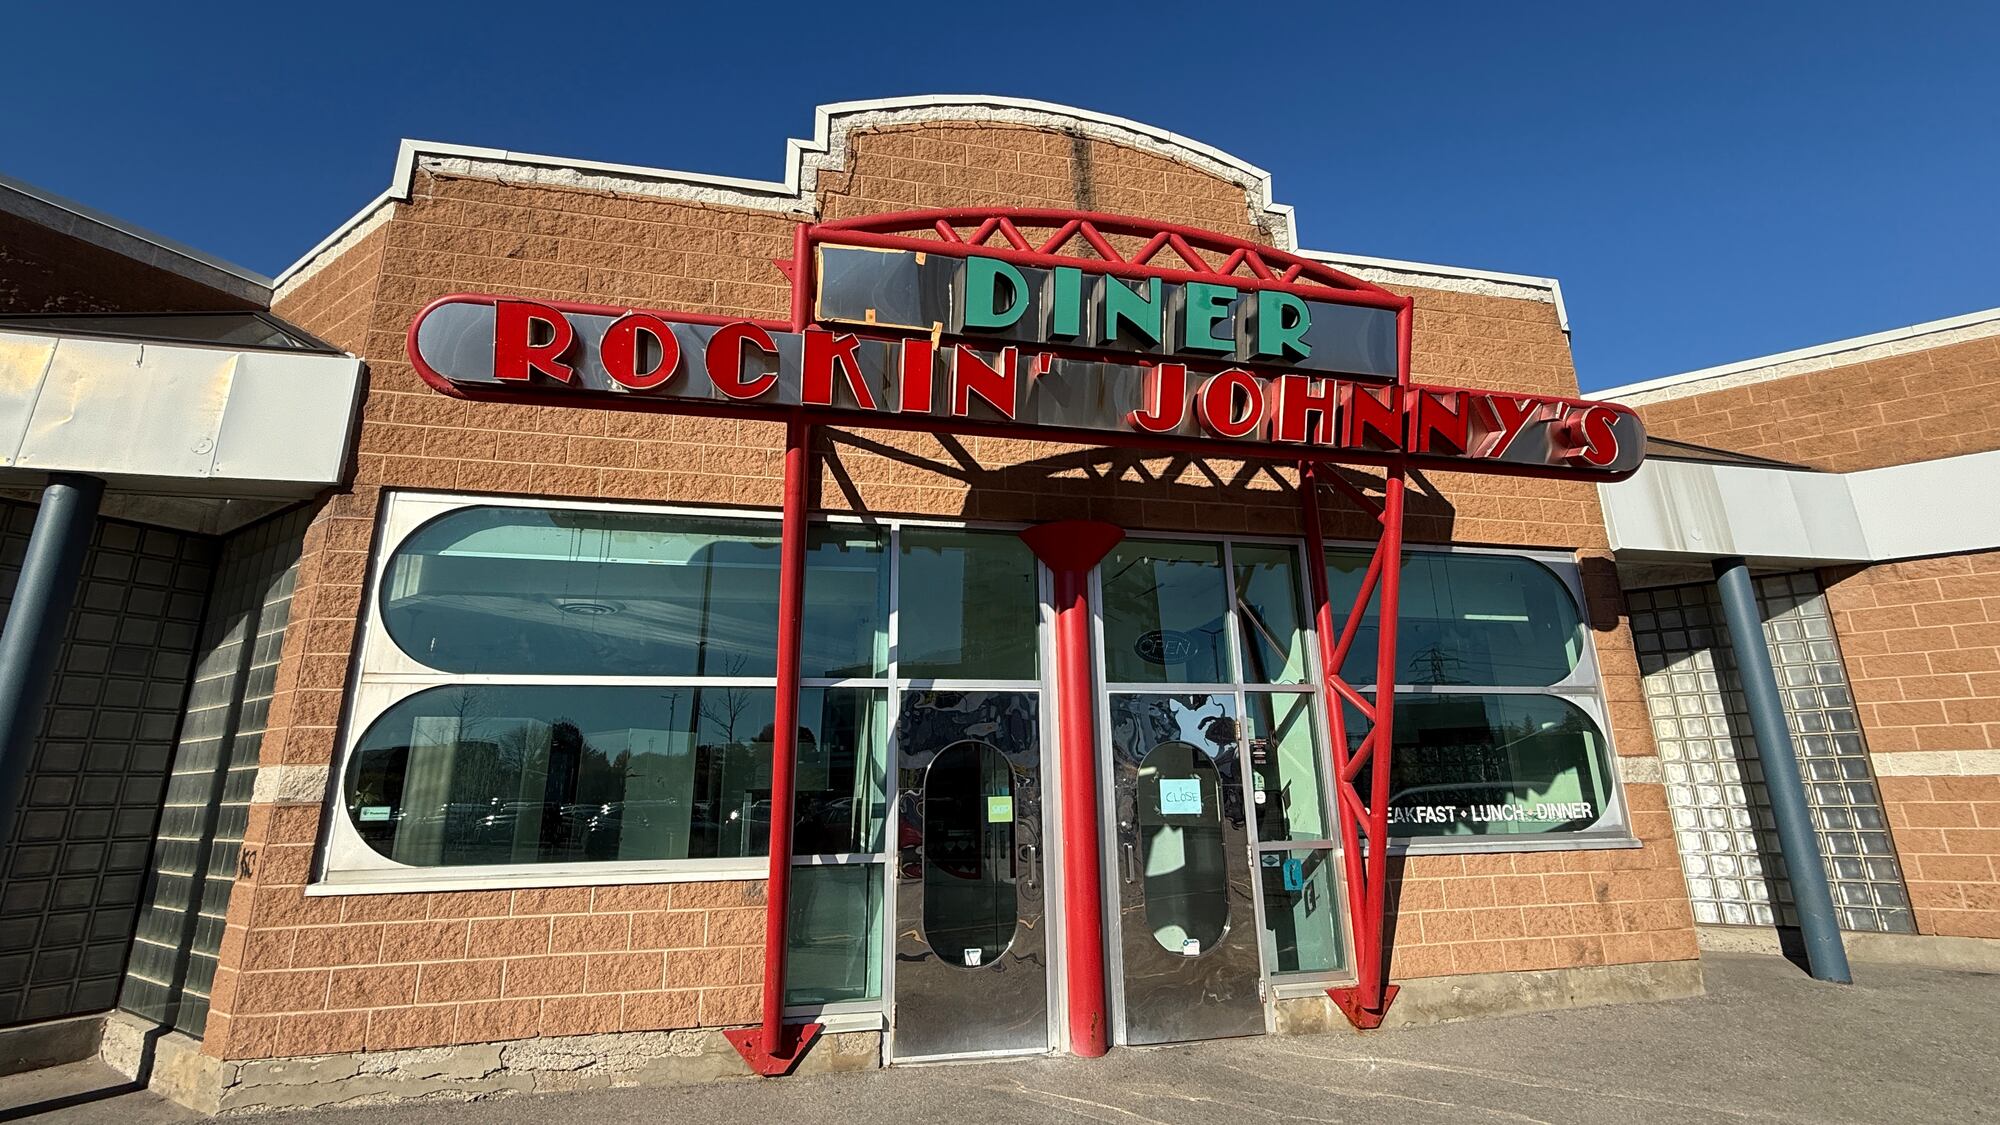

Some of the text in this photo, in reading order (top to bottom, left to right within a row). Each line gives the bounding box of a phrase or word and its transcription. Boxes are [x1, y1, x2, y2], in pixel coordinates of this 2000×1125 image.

[963, 255, 1313, 361] DINER
[493, 299, 1621, 468] ROCKIN' JOHNNY'S
[1139, 639, 1192, 656] OPEN
[1166, 790, 1199, 803] CLOSE
[1364, 802, 1594, 824] EAKFAST LUNCH DINNER
